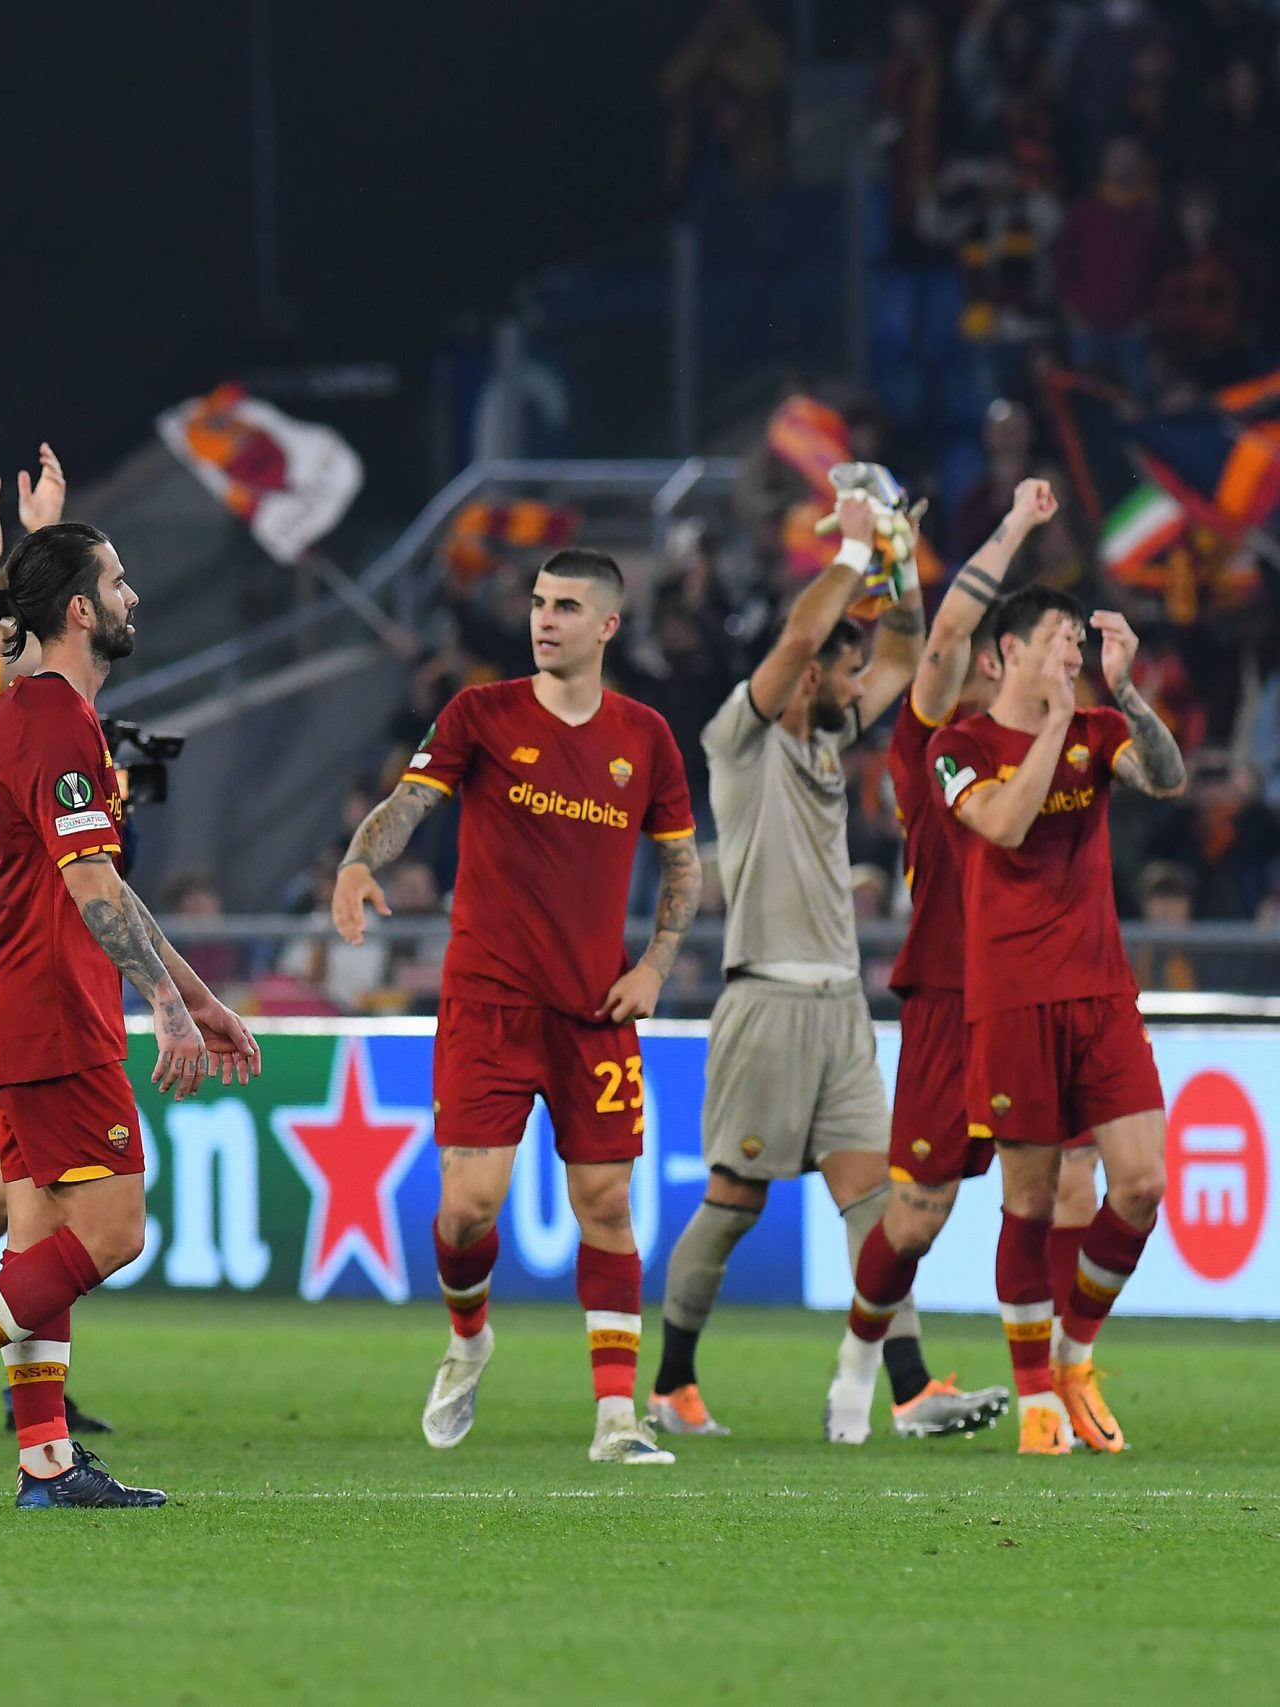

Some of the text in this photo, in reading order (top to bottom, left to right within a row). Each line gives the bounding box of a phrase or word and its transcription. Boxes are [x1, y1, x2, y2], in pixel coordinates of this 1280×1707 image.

[508, 781, 629, 829] digitalbits
[593, 1055, 644, 1114] 23
[65, 1471, 79, 1483] COPA
